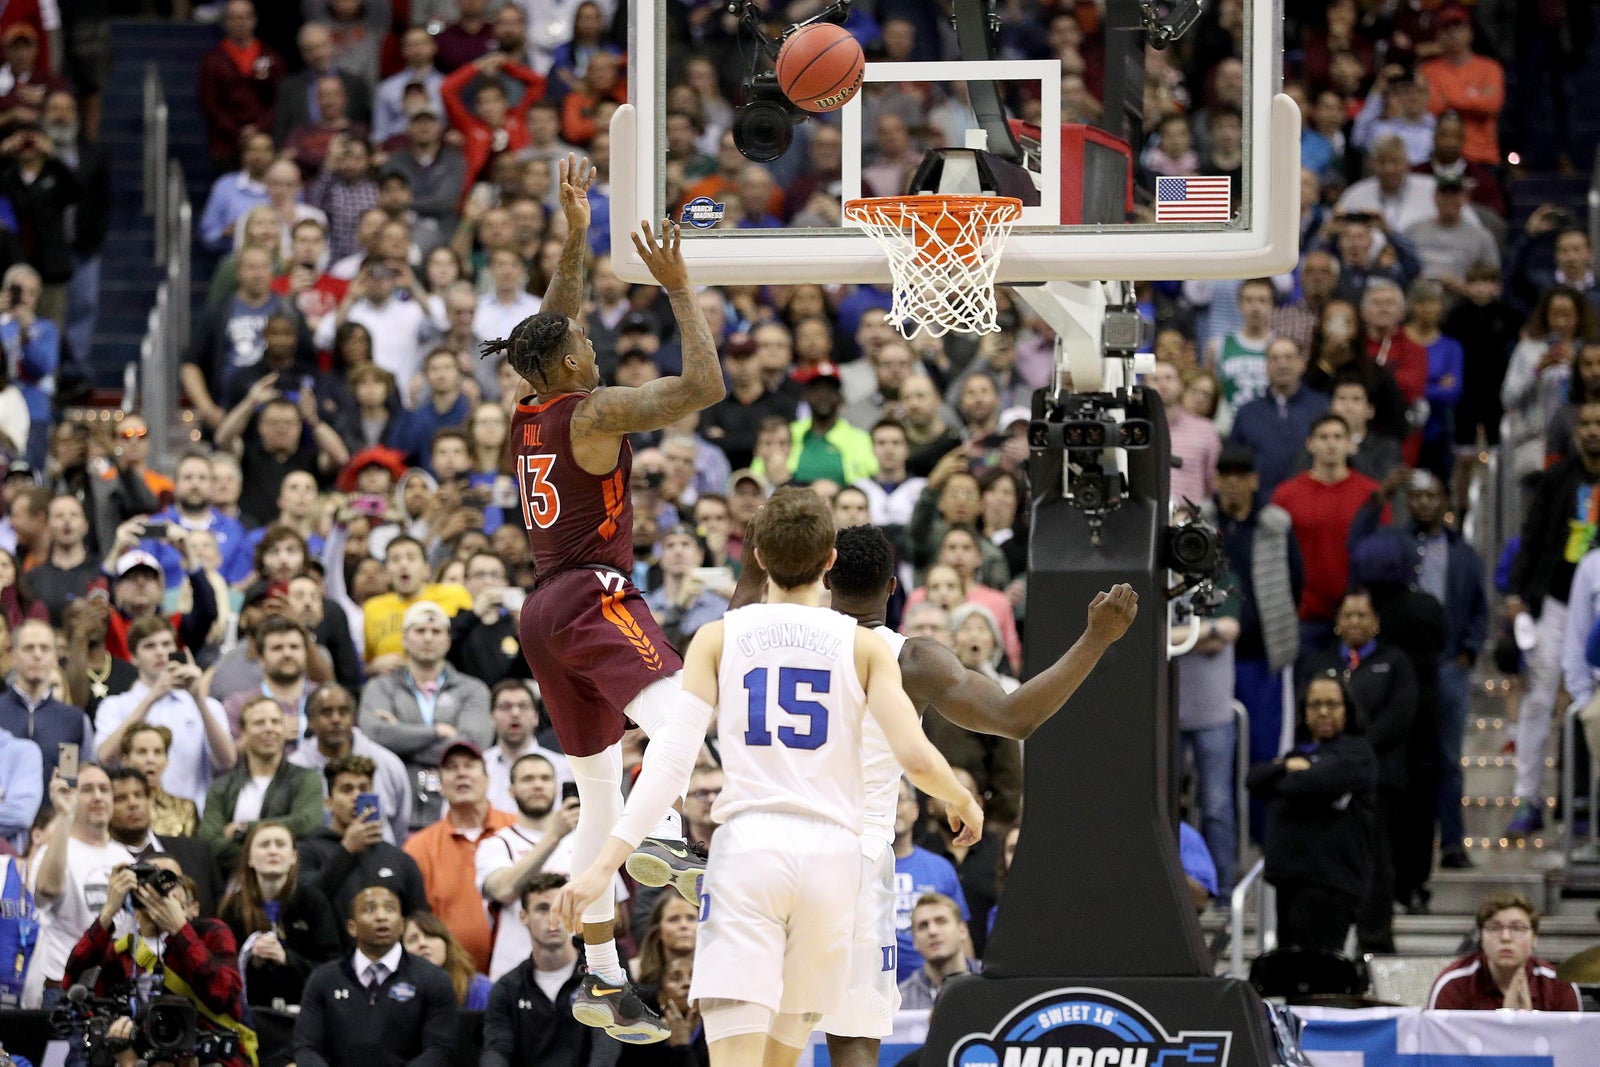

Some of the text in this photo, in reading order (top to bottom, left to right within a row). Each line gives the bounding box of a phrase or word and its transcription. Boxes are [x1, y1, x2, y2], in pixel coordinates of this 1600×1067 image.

[815, 68, 864, 109] Wilson
[523, 423, 543, 447] HILL
[517, 453, 561, 530] 13
[736, 623, 841, 662] O'CONNELL
[743, 666, 832, 751] 15
[1037, 1005, 1115, 1029] SWEET 16
